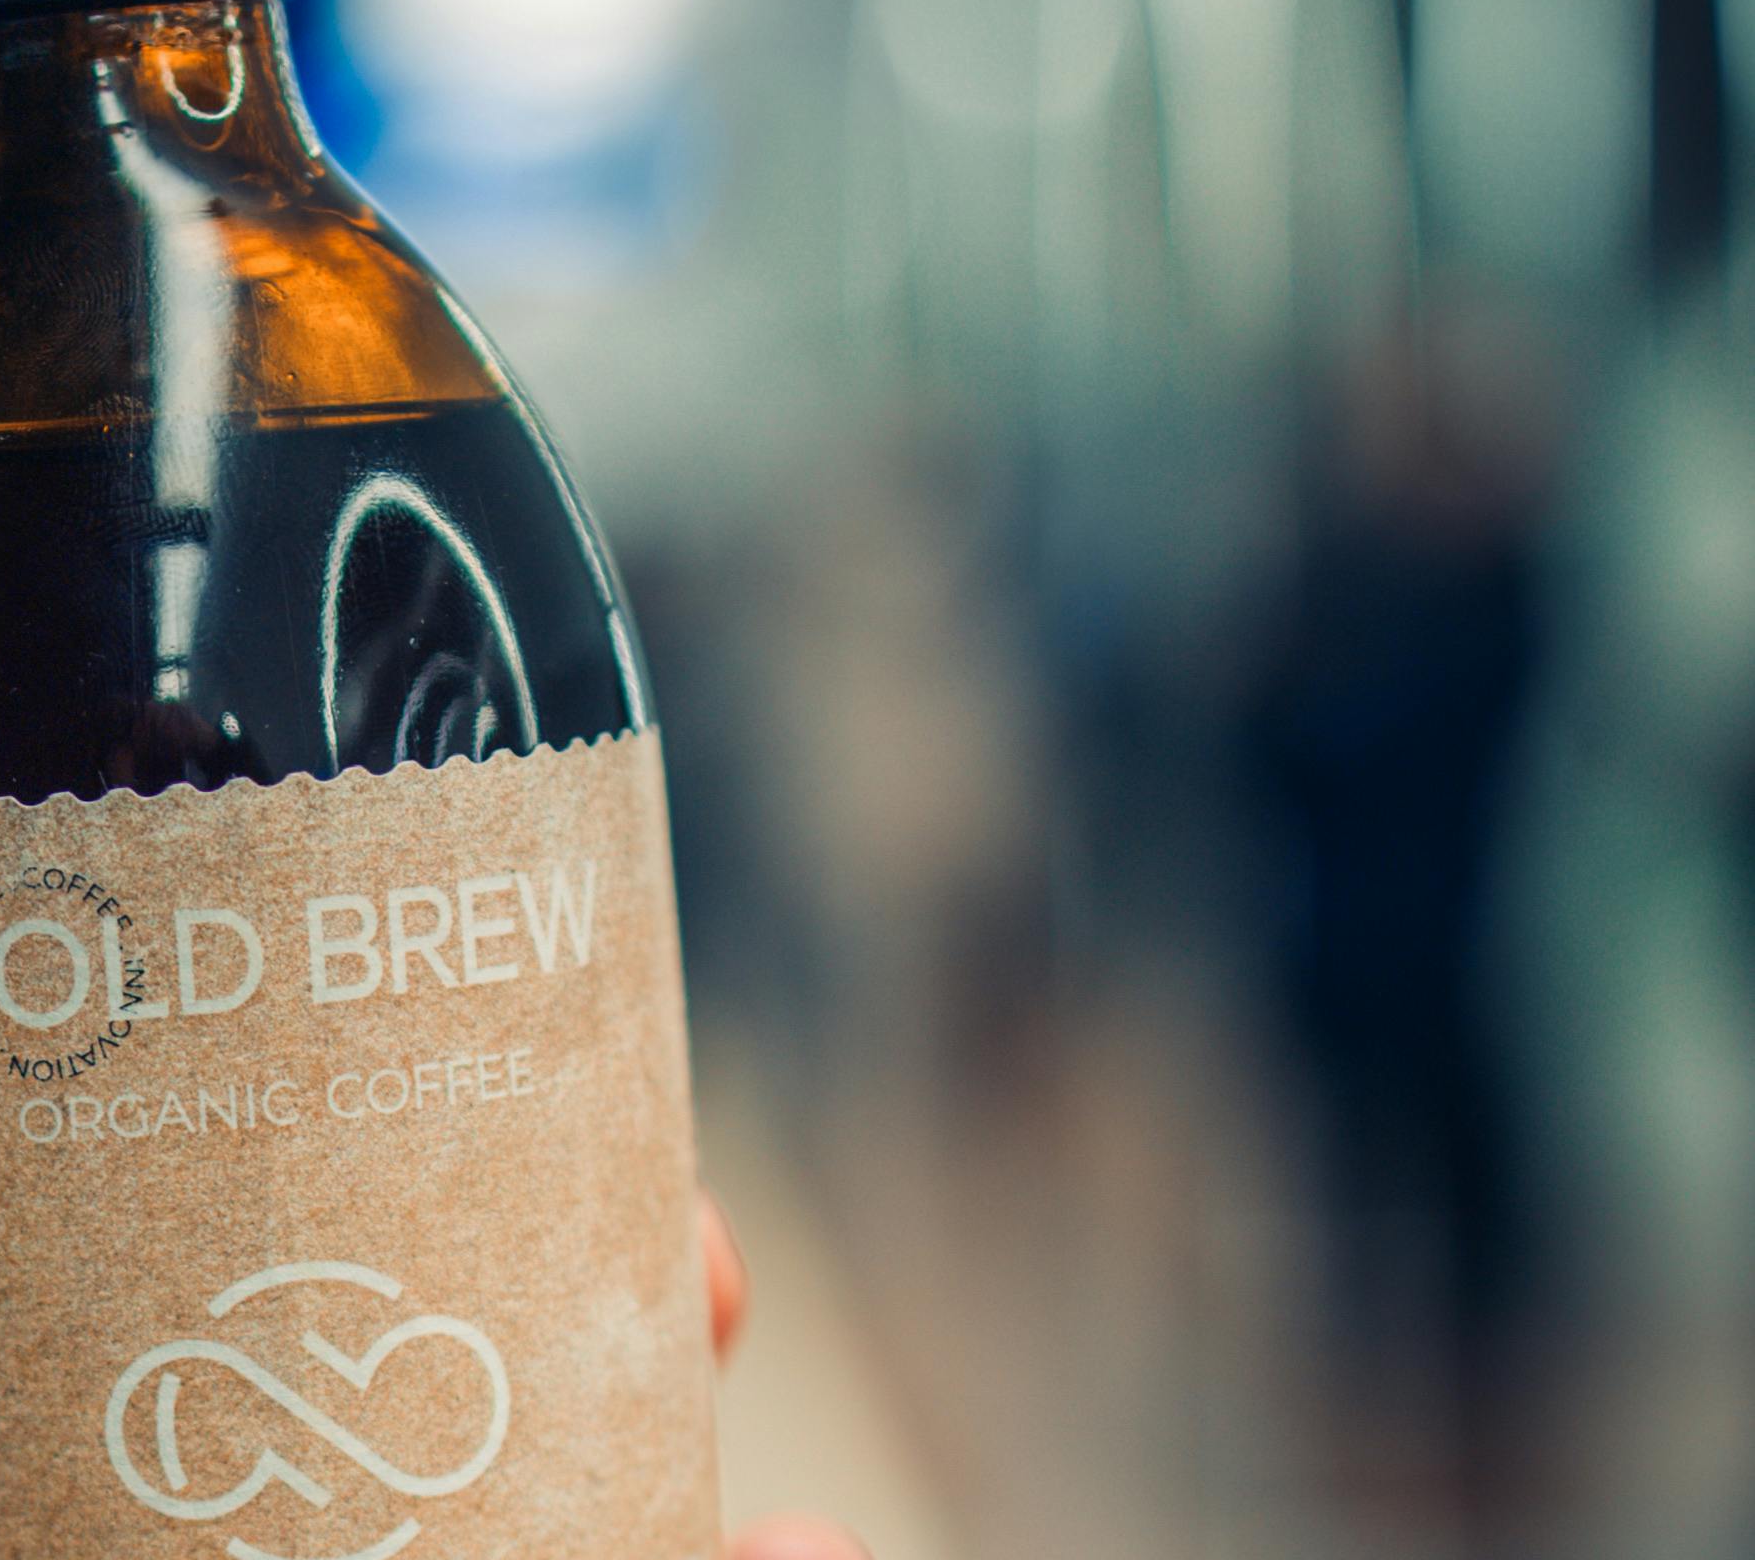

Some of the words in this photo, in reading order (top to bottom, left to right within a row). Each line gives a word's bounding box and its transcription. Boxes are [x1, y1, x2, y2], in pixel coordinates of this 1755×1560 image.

[306, 860, 597, 1004] BREW
[19, 1079, 300, 1143] ORGANIC
[326, 1047, 535, 1119] COFFEE
